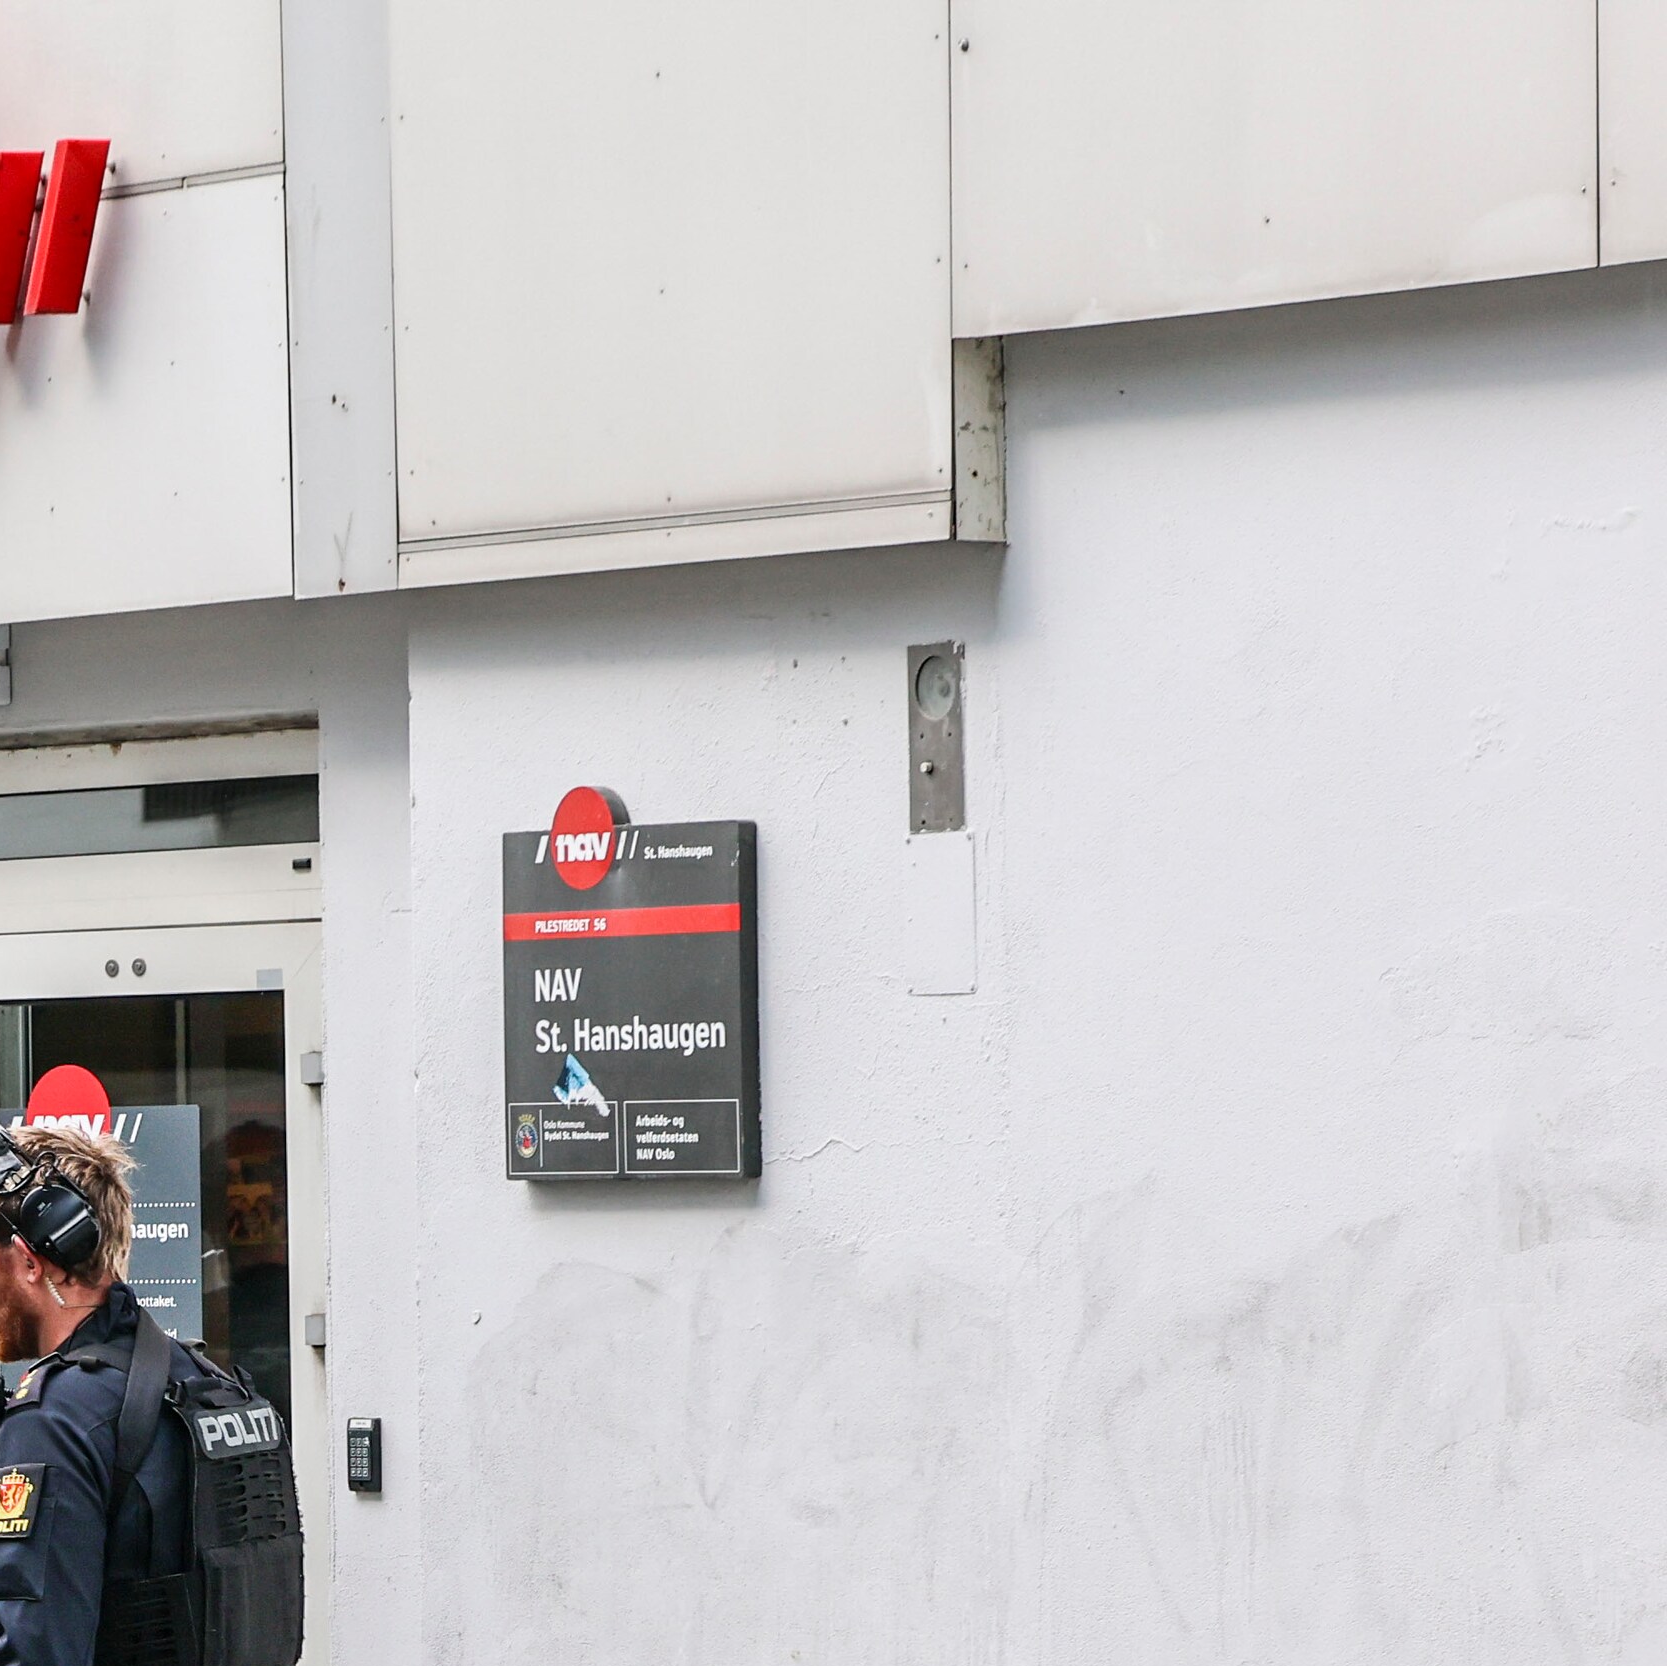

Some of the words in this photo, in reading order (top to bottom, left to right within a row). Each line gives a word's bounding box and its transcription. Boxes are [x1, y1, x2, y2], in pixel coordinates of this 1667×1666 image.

[555, 832, 612, 863] nav
[658, 844, 713, 860] Hanshaugen
[534, 918, 591, 934] PILESTREDET
[593, 917, 607, 932] 56
[534, 967, 582, 1003] NAV
[535, 1018, 568, 1053] St.
[573, 1015, 727, 1057] Hanshaugen
[636, 1114, 671, 1127] Arbeids-
[672, 1116, 685, 1129] og
[636, 1131, 699, 1144] velferdsetaten
[636, 1148, 654, 1161] NAV
[655, 1147, 676, 1161] Oslo
[198, 1407, 279, 1452] POLITI
